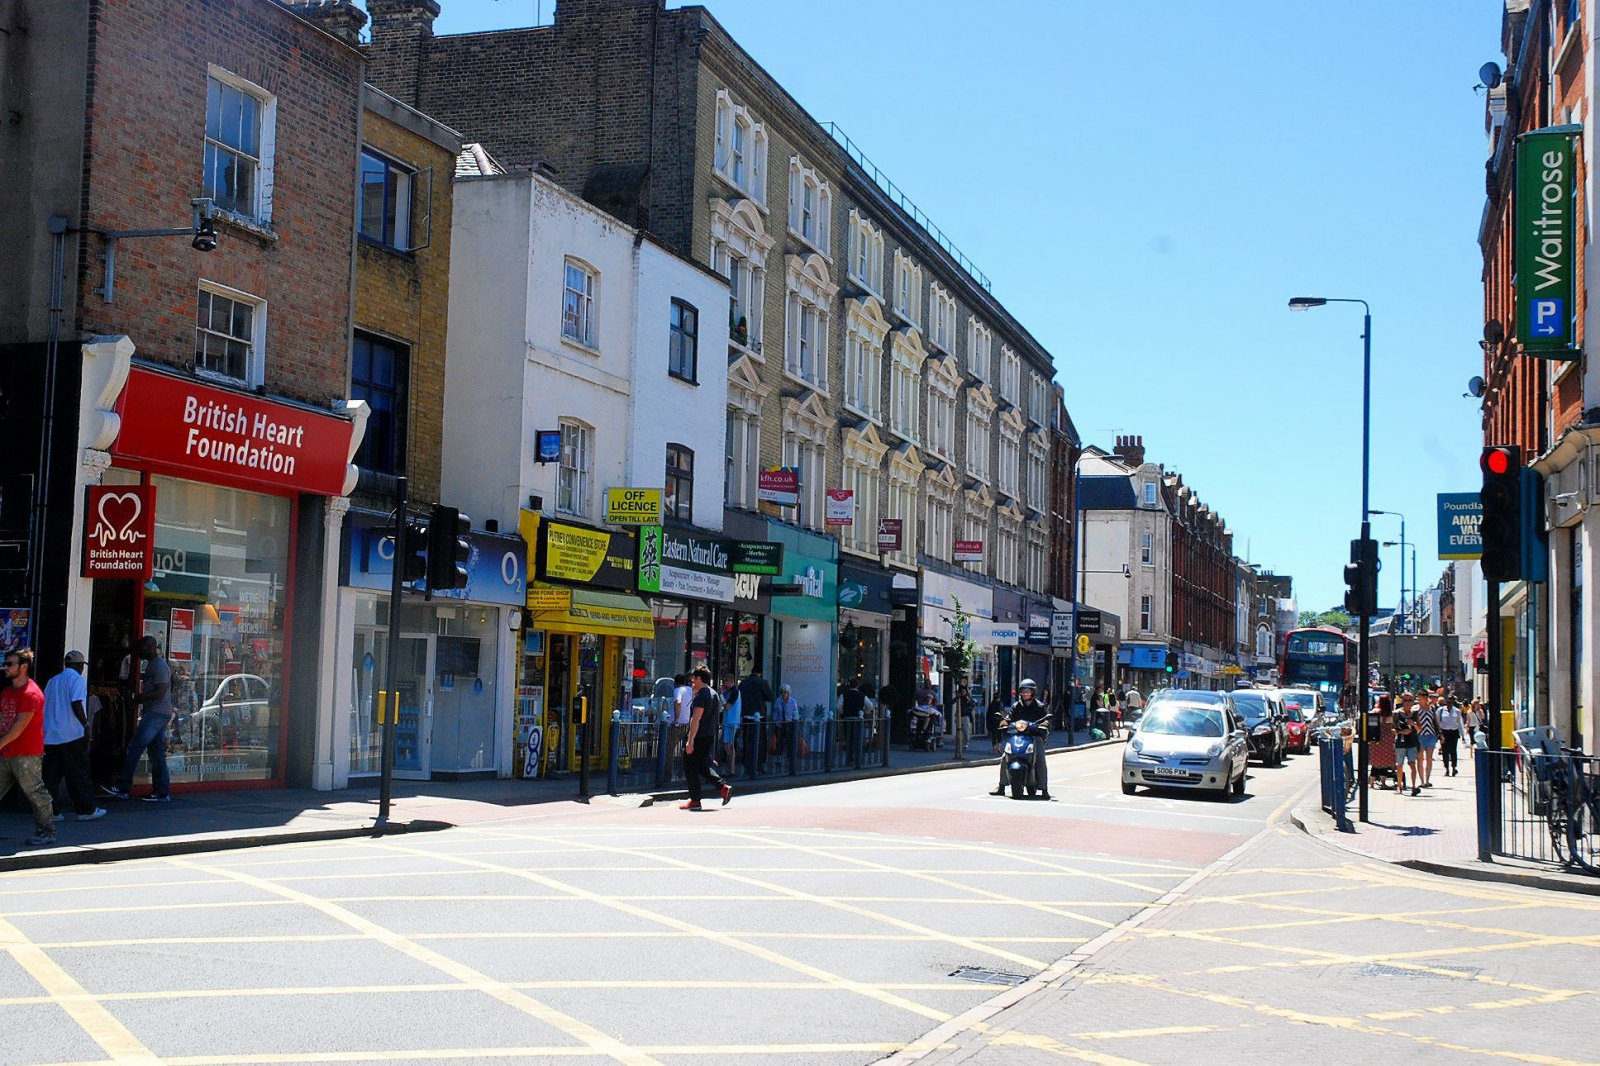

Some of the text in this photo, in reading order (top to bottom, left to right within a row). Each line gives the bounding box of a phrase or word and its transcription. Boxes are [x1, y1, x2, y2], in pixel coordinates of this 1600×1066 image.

[1533, 151, 1564, 292] Waitrose
[1537, 302, 1556, 324] P
[183, 396, 304, 449] British Heart
[186, 428, 296, 476] Foundation
[760, 474, 793, 482] kfh.co.uk
[624, 490, 645, 500] OFF
[612, 501, 656, 511] LICENCE
[1444, 502, 1483, 510] Poundla
[1460, 525, 1480, 535] VAL
[1450, 535, 1482, 545] EVERY
[90, 550, 143, 559] British Heart
[662, 533, 687, 561] Eastern
[688, 538, 713, 565] Natural
[713, 544, 728, 570] Care
[90, 560, 143, 569] Foundation
[992, 630, 1017, 638] maplin
